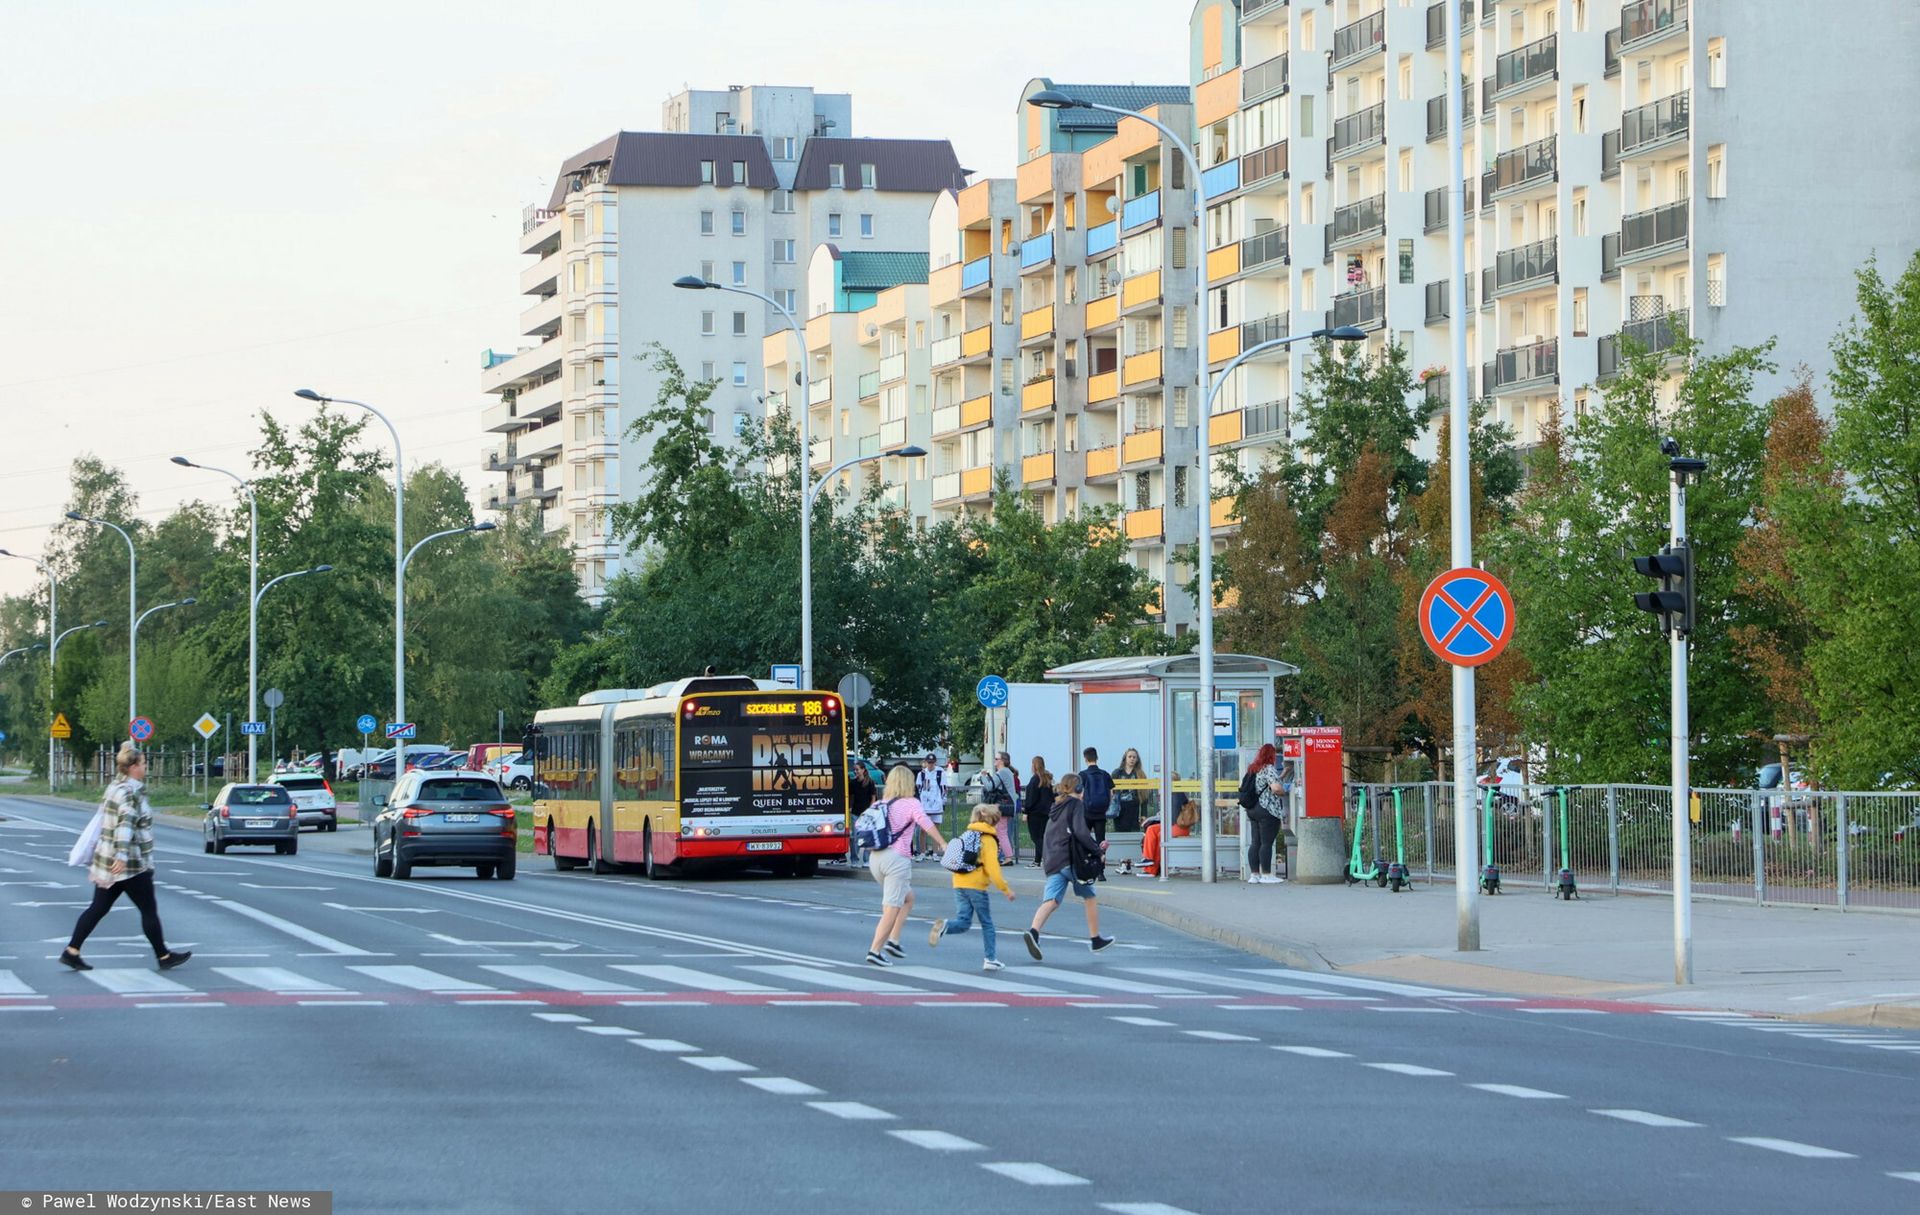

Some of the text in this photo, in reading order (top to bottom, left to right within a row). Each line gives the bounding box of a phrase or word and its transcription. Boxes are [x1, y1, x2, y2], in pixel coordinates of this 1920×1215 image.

[802, 701, 822, 715] 186
[805, 715, 828, 726] 5412
[244, 723, 265, 733] TAXI
[388, 725, 414, 736] TAXI
[694, 735, 728, 745] ROMA
[773, 734, 812, 744] WE WILL
[792, 775, 833, 790] YOU
[753, 799, 783, 808] QUEEN
[788, 797, 834, 806] BEN ELTON
